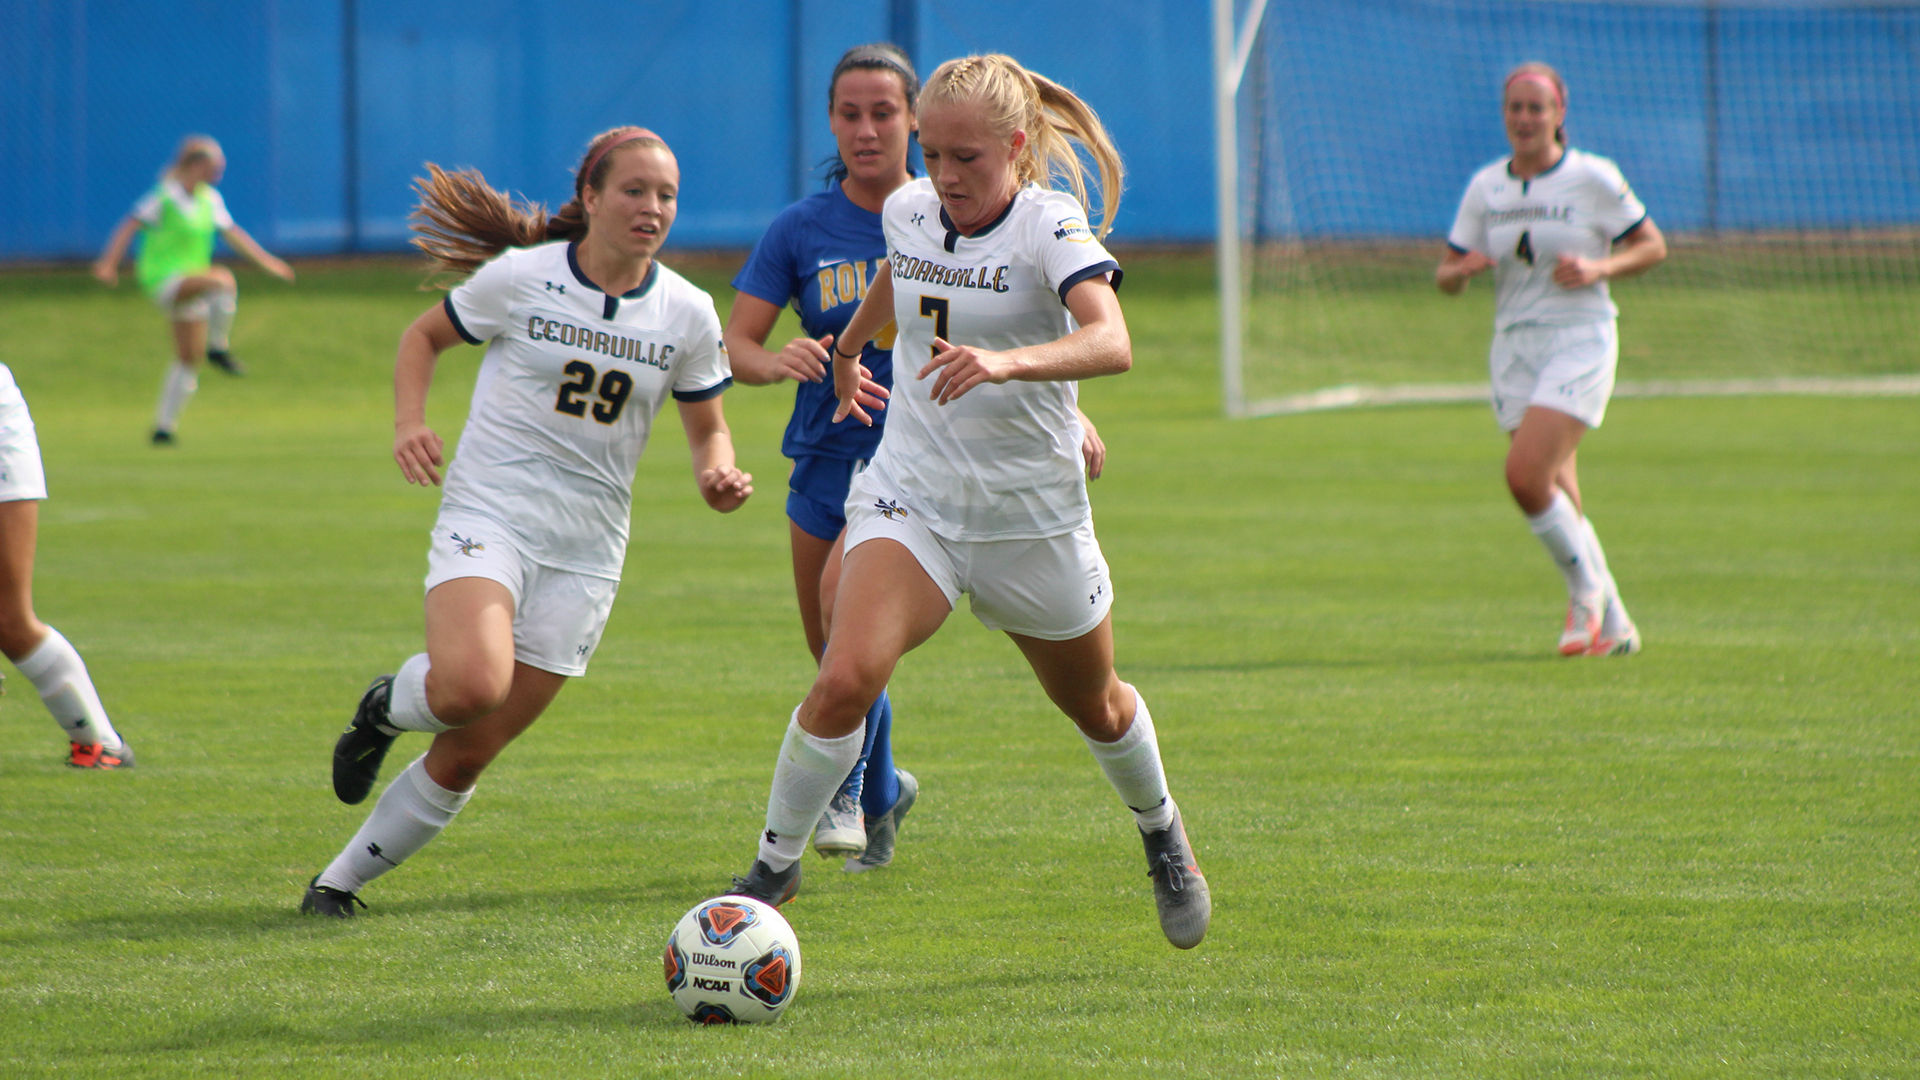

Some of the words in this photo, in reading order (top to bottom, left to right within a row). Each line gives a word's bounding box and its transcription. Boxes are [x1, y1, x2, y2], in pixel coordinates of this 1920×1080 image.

[1515, 230, 1535, 267] 4
[818, 257, 887, 313] ROL
[528, 316, 676, 372] CEDARVILLE
[919, 294, 950, 360] 7
[555, 359, 635, 426] 29
[692, 952, 737, 969] Wilson
[693, 976, 731, 993] NCAA
